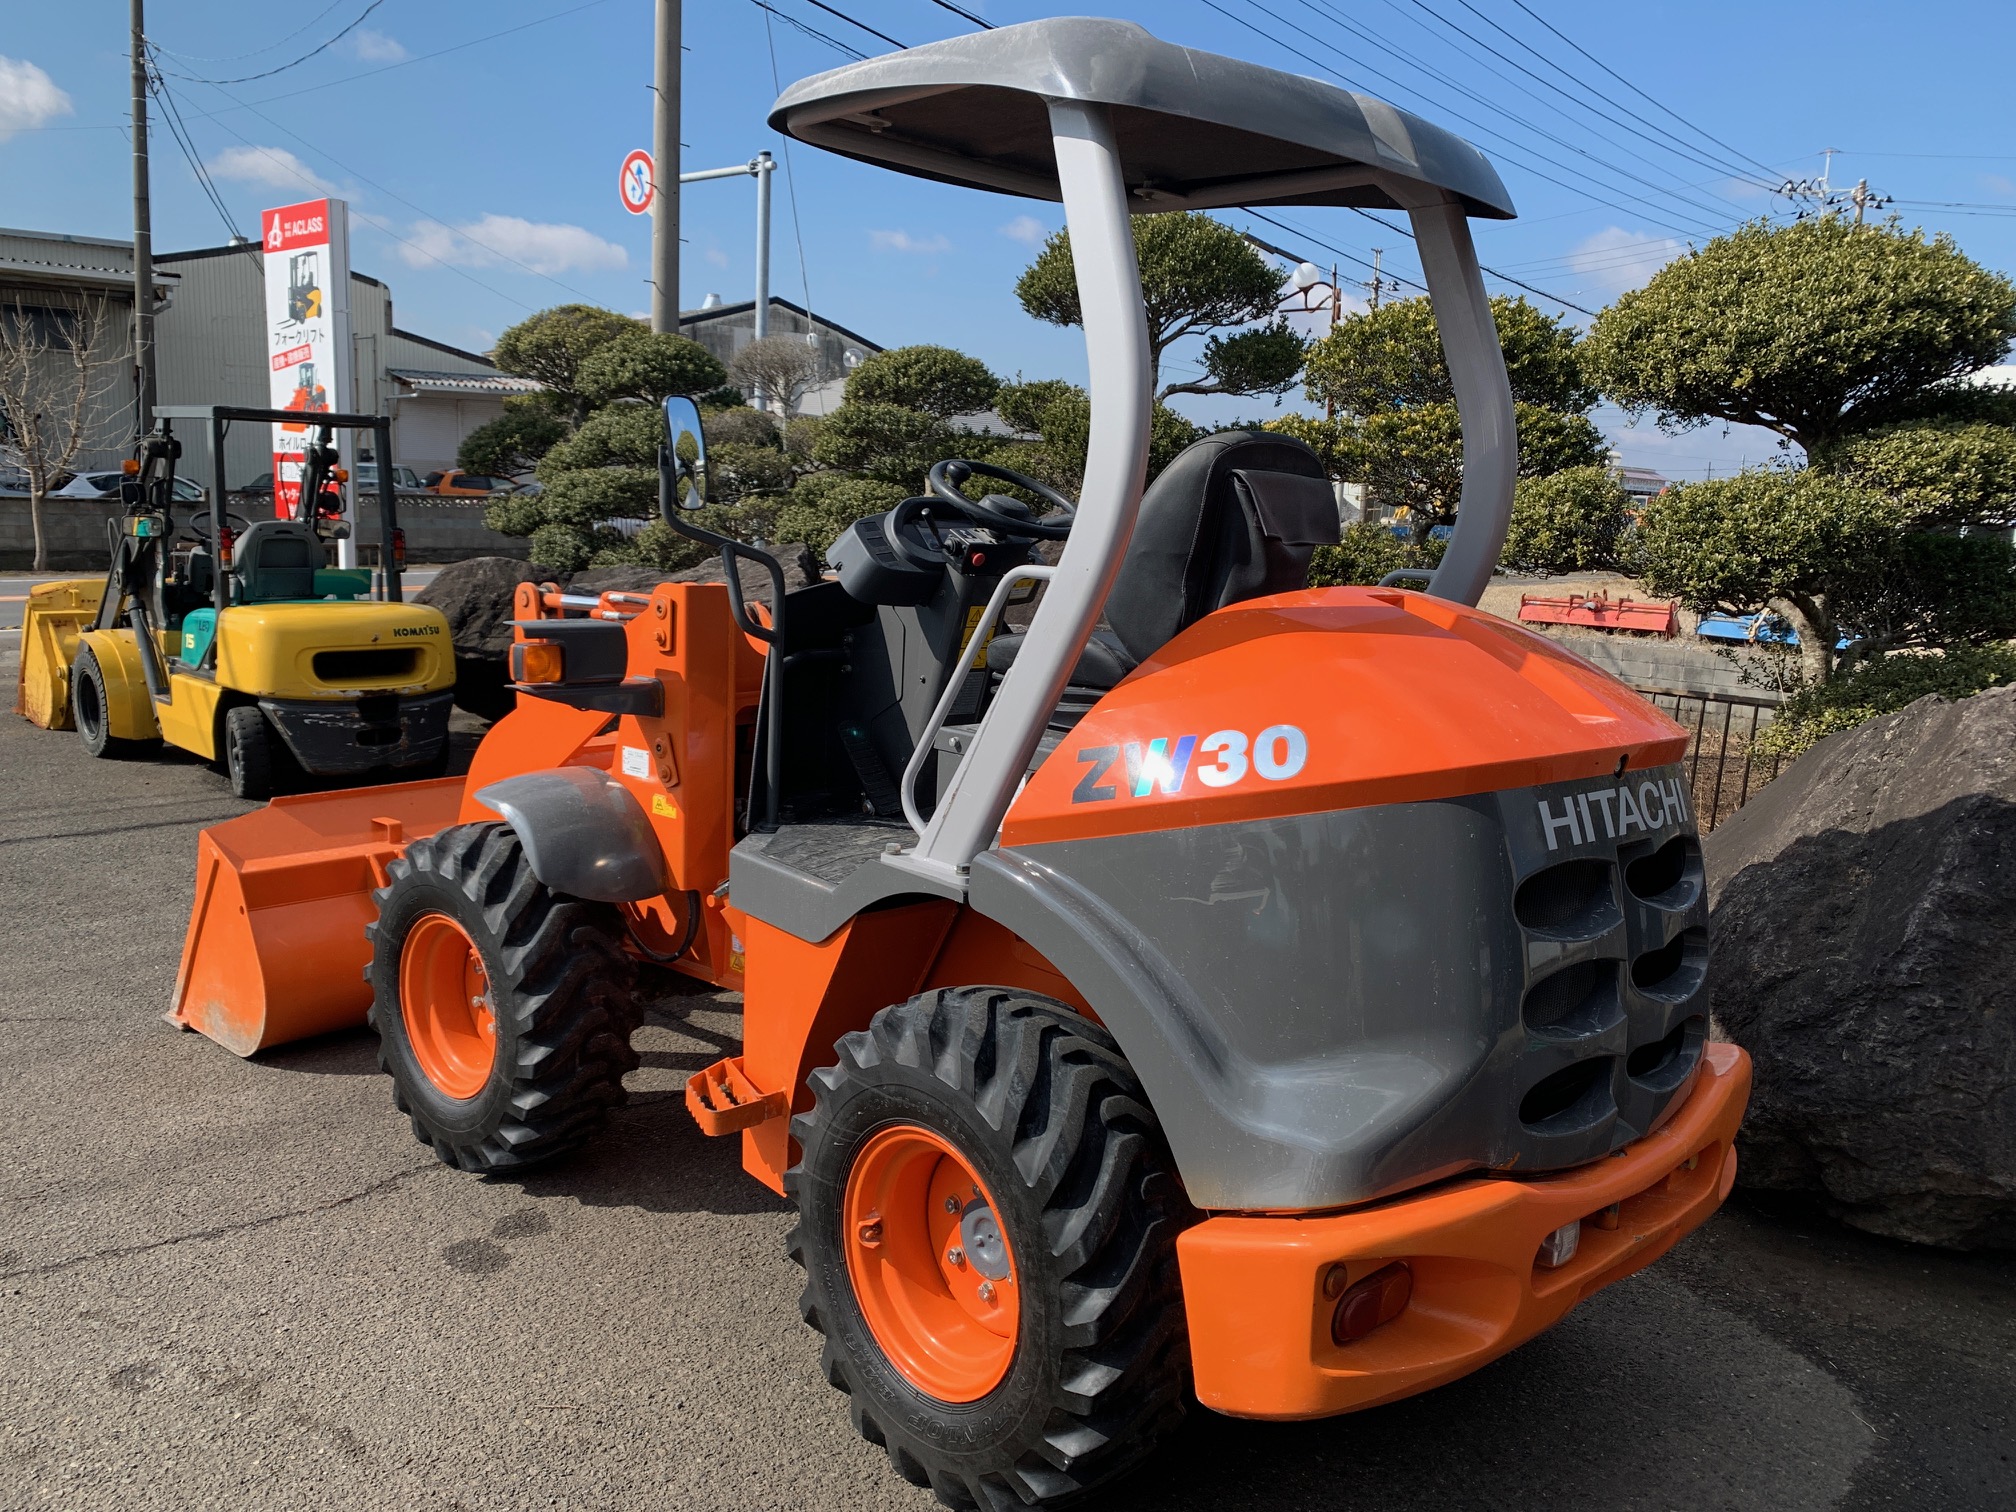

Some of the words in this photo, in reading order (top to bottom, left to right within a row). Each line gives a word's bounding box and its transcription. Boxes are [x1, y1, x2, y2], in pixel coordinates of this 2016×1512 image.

[292, 217, 323, 235] ACLASS
[275, 330, 324, 345] フォークリフト
[279, 437, 307, 450] ホイルロ
[393, 625, 440, 637] KOMATSU
[185, 633, 195, 649] 15
[1072, 725, 1307, 803] ZW30
[1539, 778, 1688, 851] HITACHI
